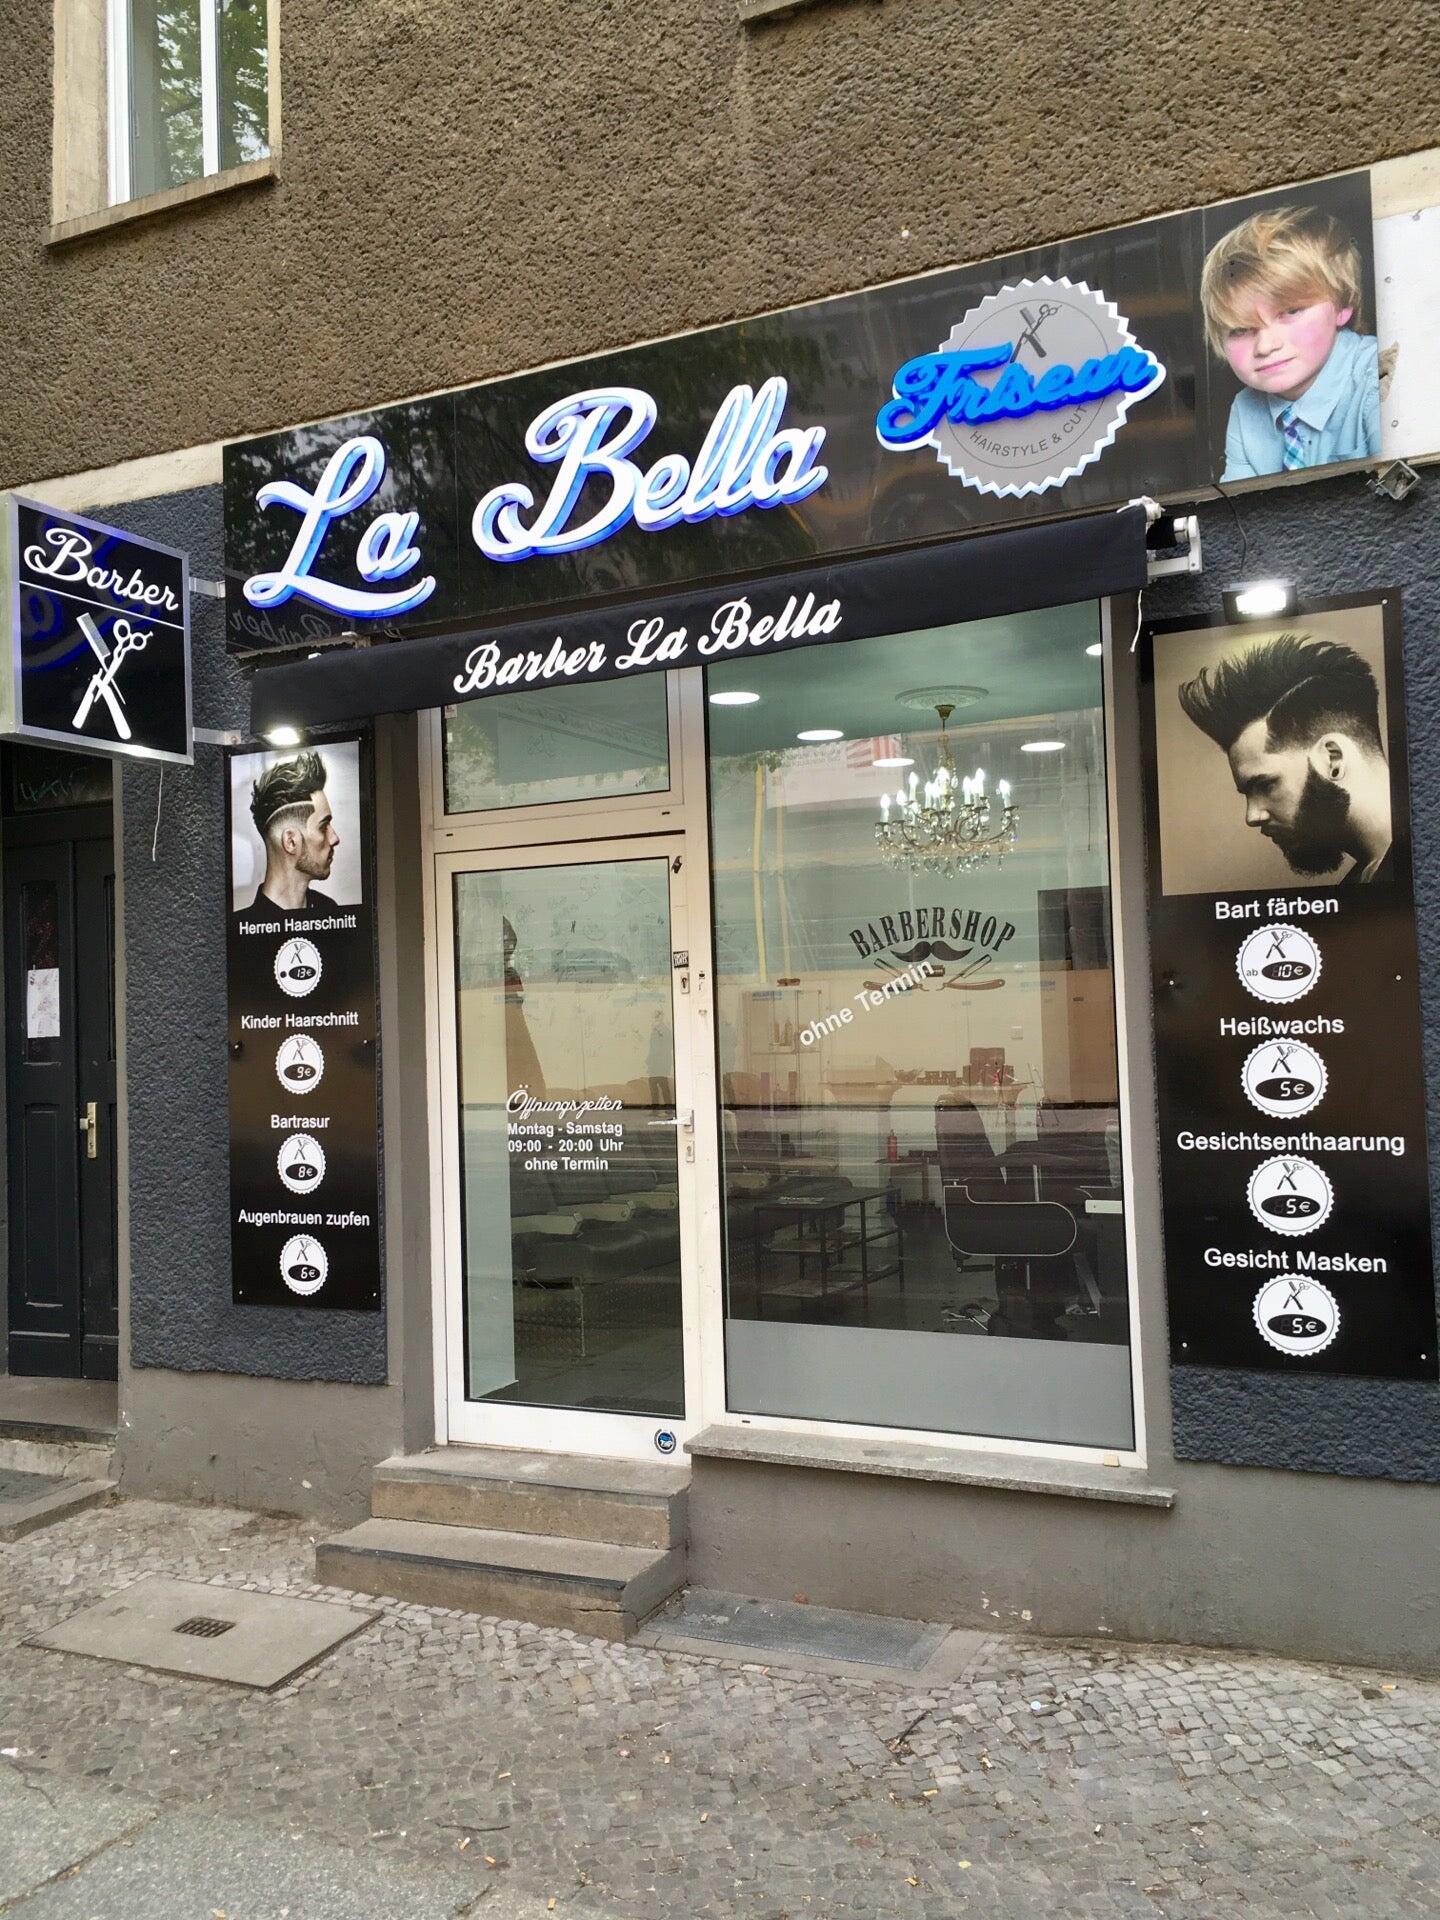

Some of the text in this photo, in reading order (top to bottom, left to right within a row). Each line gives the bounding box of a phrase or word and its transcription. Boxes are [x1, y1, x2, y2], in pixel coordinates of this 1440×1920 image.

[876, 341, 1160, 445] Friseur
[969, 404, 1090, 458] HAIRSTYLE & CUT
[243, 376, 828, 618] La Bella
[23, 527, 179, 611] Barber
[453, 591, 842, 693] Barber La Bella
[1214, 896, 1339, 919] Bart färben
[239, 914, 357, 935] Herren Haarschnitt
[849, 906, 1016, 959] BARBERSHOP
[1246, 968, 1258, 977] ab
[799, 960, 935, 1047] ohne Termin
[241, 1011, 359, 1030] Kinder Haarschnitt
[1219, 1014, 1345, 1036] Heißwachs
[506, 1083, 623, 1120] Öffnungszeiten
[270, 1114, 330, 1129] Bartrasur
[507, 1123, 554, 1138] Montag
[566, 1121, 623, 1137] Samstag
[508, 1139, 542, 1152] 09:00
[558, 1138, 593, 1152] 20:00
[600, 1138, 624, 1152] Uhr
[1176, 1131, 1405, 1157] Gesichtsenthaarung
[524, 1156, 609, 1171] ohne Termin
[238, 1208, 370, 1229] Augenbrauen zupfen
[1203, 1247, 1387, 1273] Gesicht Masken
